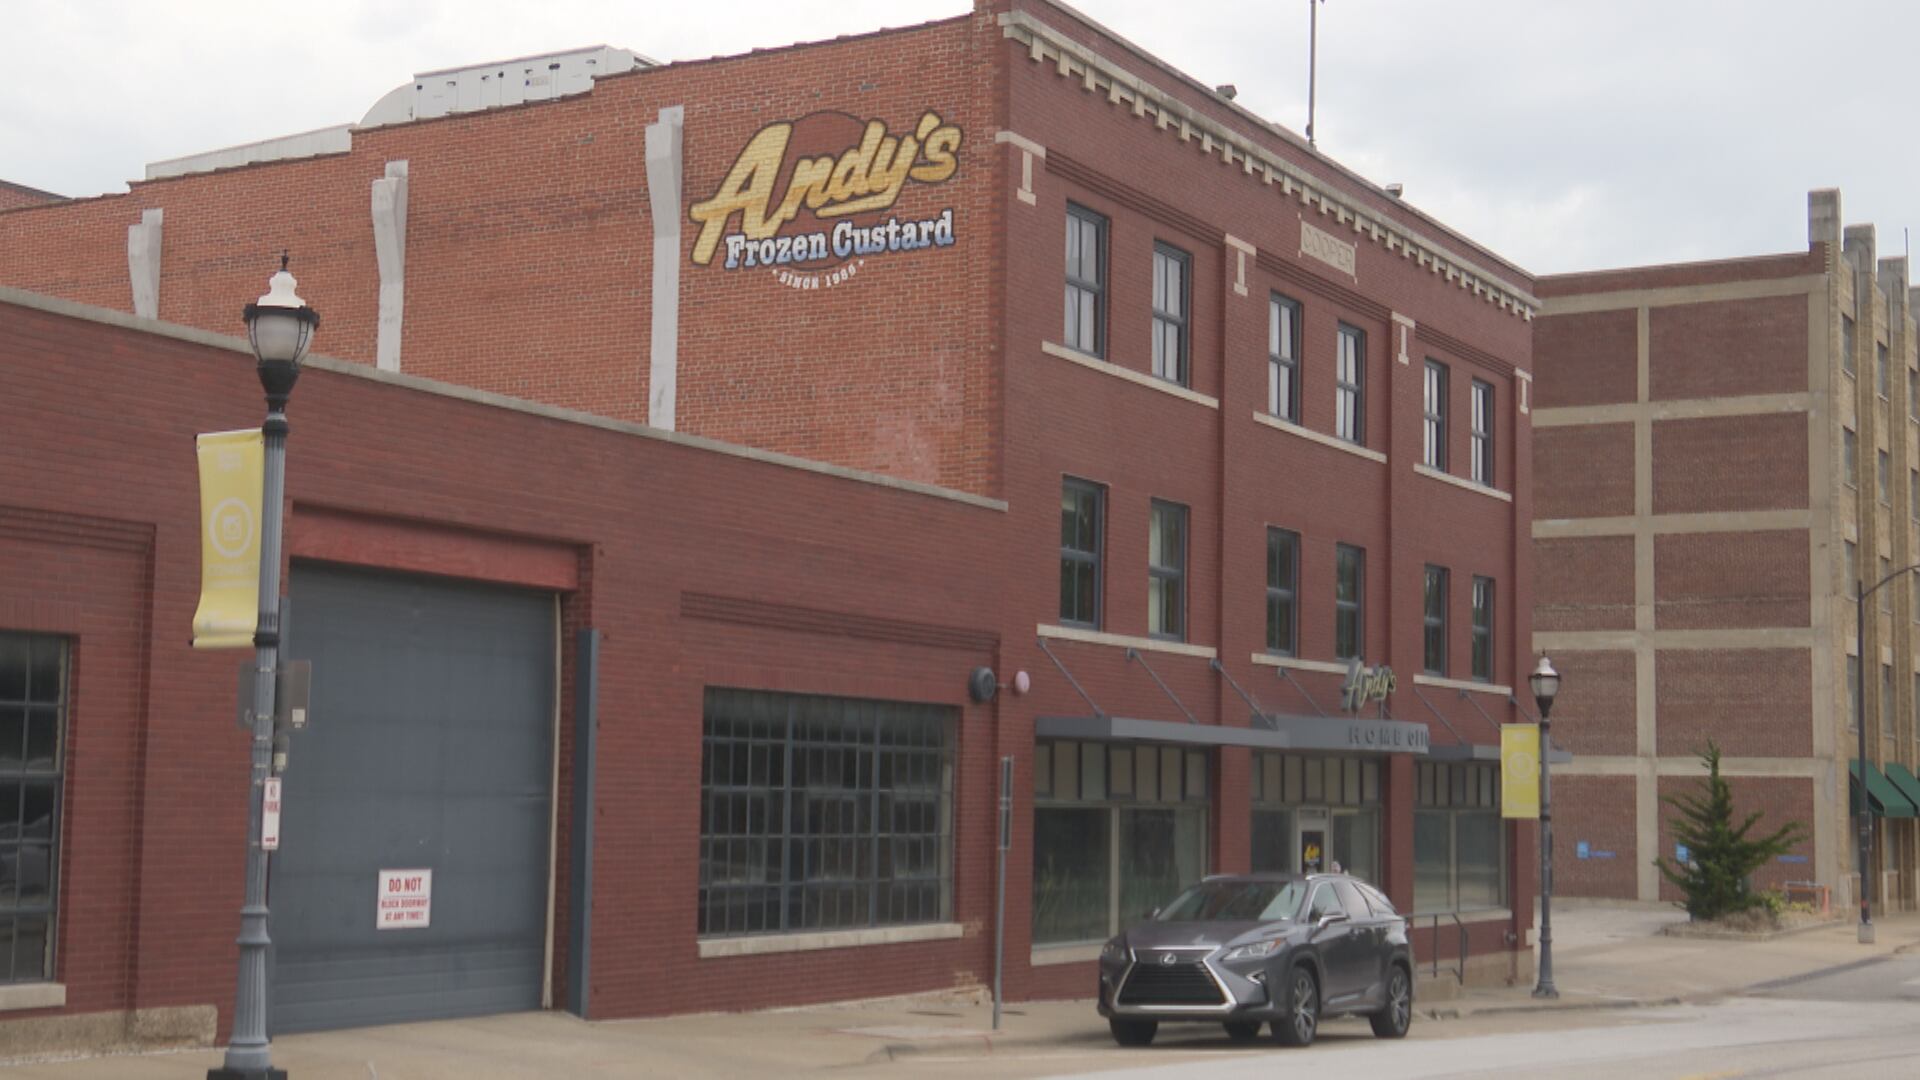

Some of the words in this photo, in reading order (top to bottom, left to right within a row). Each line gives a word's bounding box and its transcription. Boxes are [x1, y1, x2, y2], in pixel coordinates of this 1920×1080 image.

[689, 110, 964, 265] Andy's
[725, 231, 829, 269] Frozen
[832, 209, 954, 256] Custard
[388, 878, 401, 892] DO
[404, 877, 422, 892] NOT
